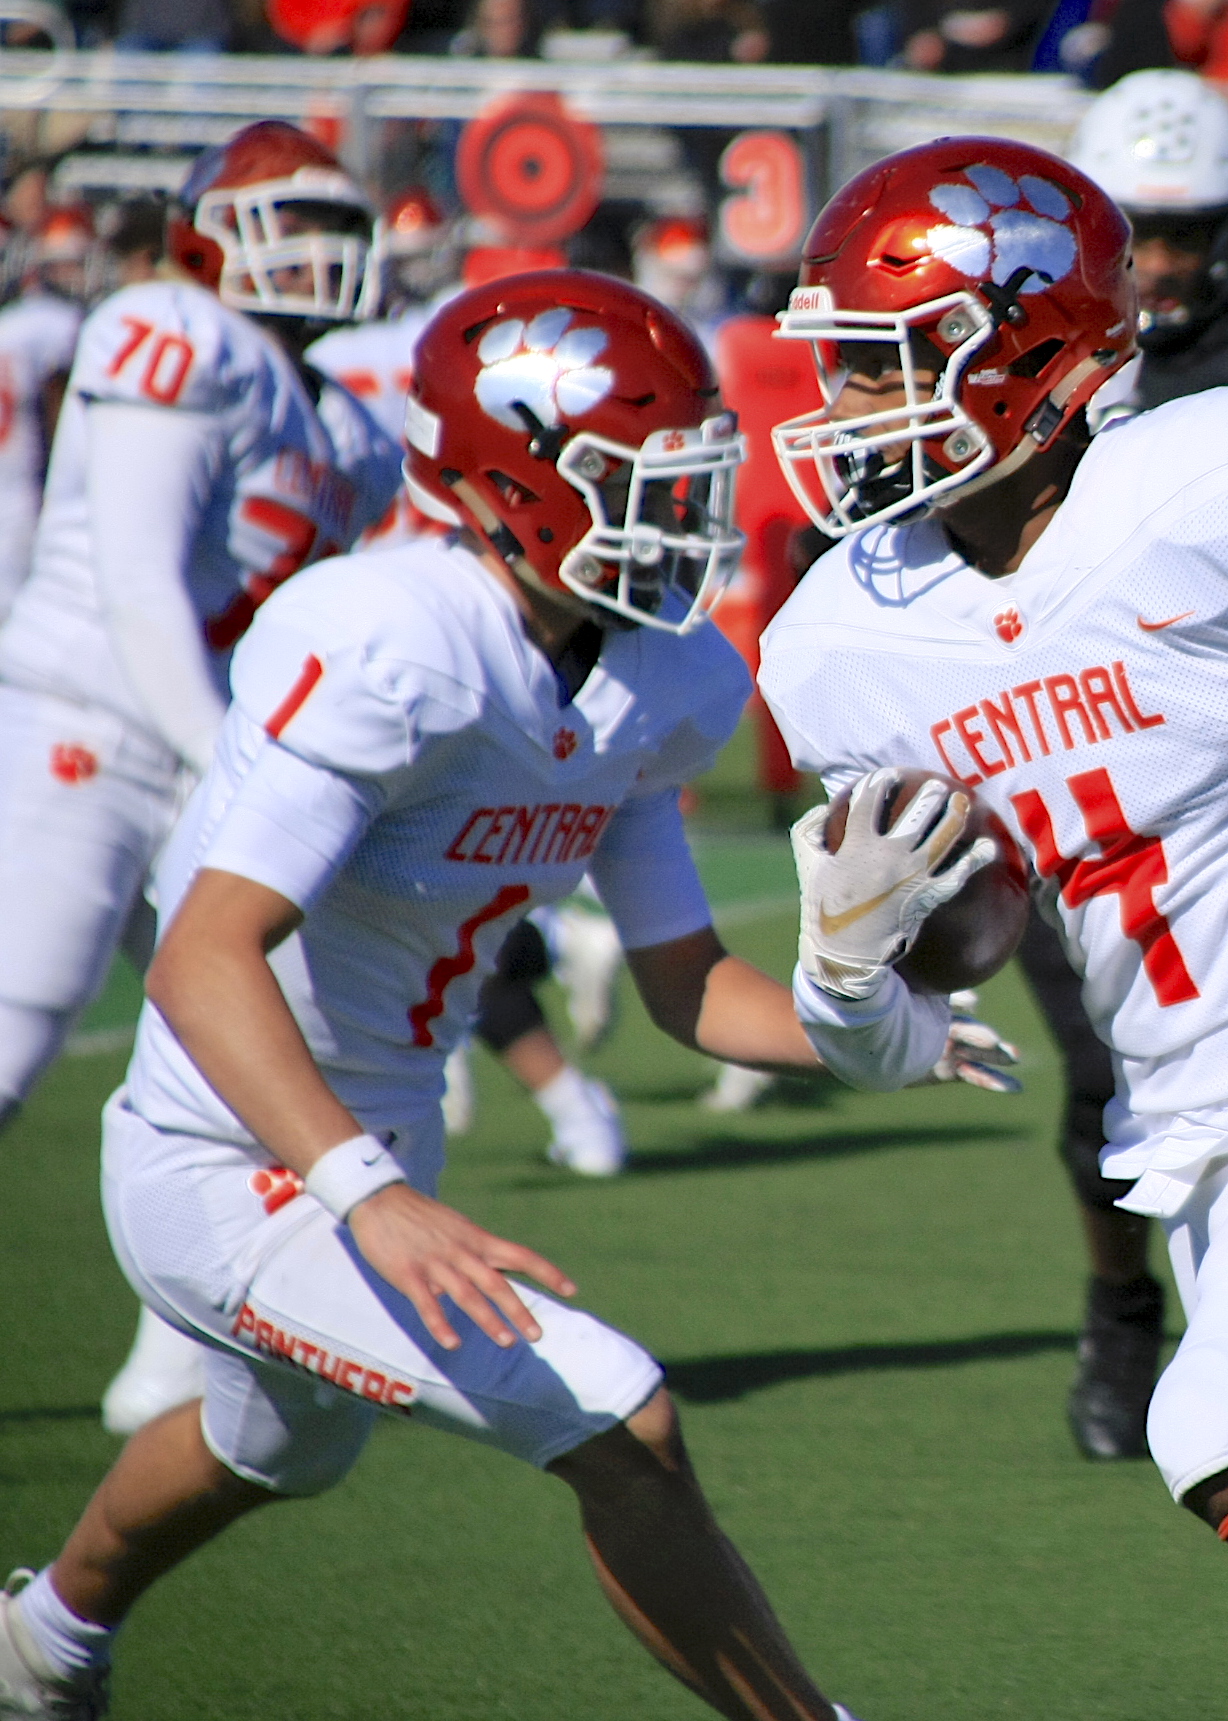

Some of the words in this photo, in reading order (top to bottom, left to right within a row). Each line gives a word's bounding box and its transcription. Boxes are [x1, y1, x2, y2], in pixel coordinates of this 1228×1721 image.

[723, 131, 804, 258] 3
[106, 315, 196, 407] 70
[265, 651, 324, 738] 1
[931, 660, 1166, 788] CENTRAL
[1009, 766, 1202, 1008] 4
[408, 884, 530, 1048] 1
